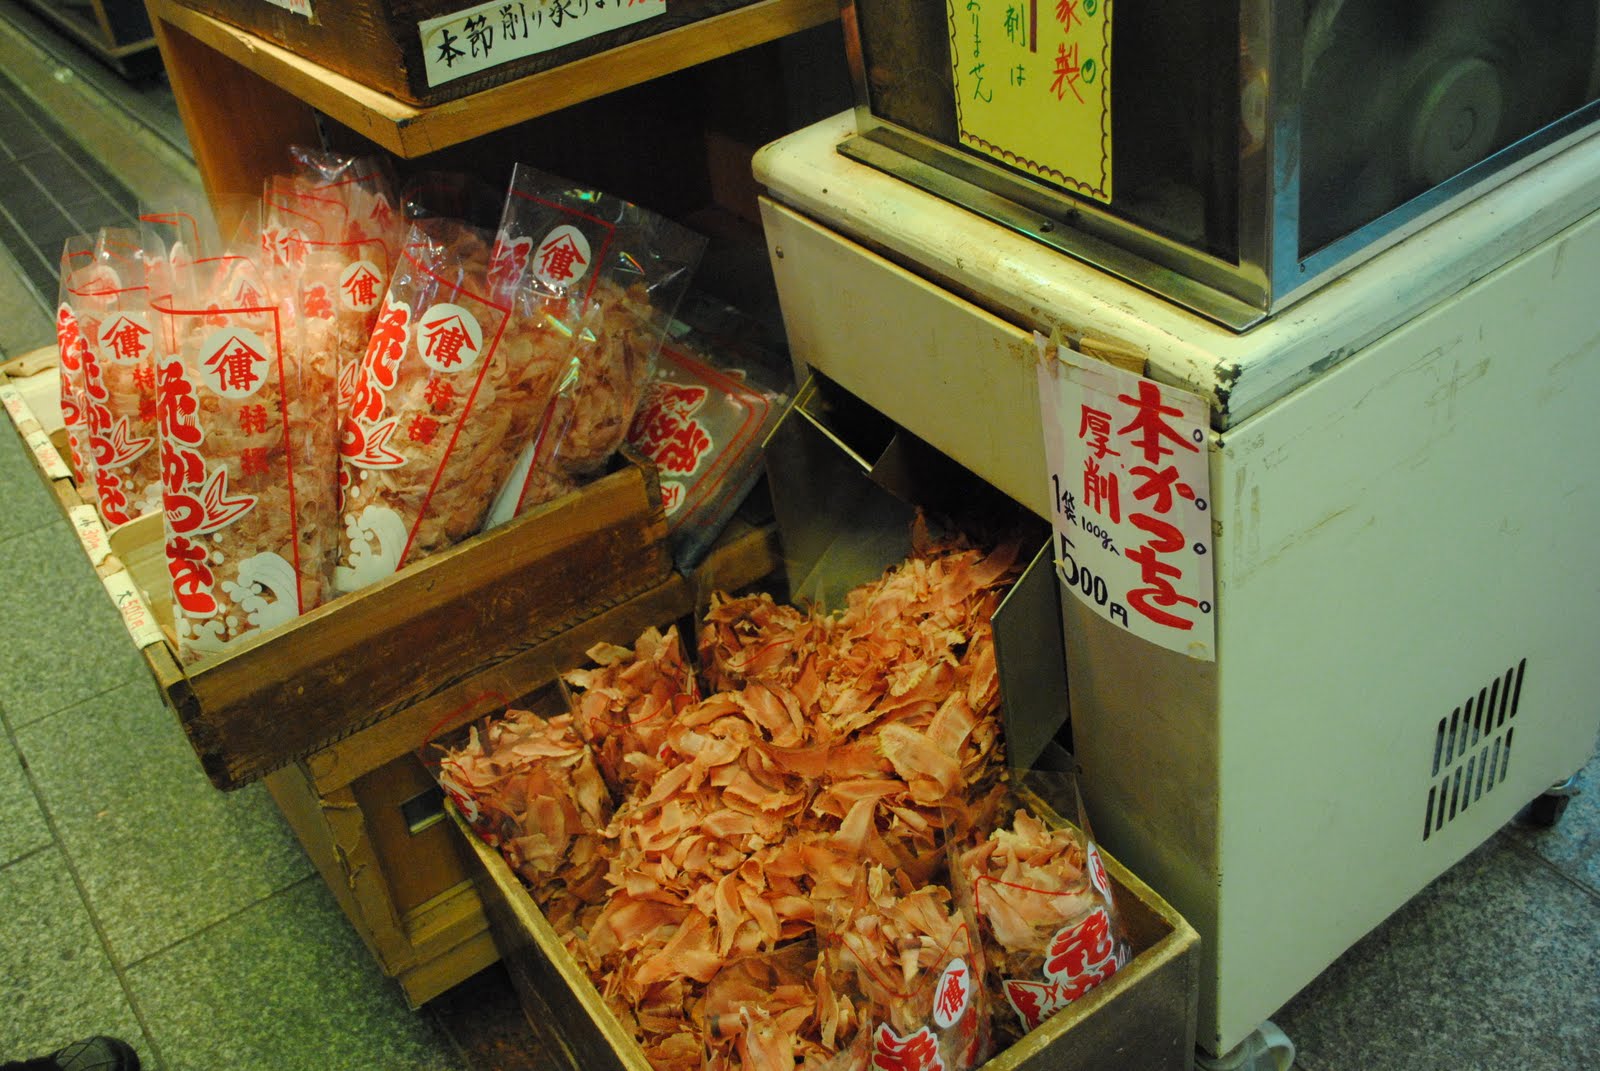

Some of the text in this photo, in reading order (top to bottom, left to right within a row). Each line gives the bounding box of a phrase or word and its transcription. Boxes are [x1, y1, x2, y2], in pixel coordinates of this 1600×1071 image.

[436, 0, 621, 68] 本節削り承り
[1078, 404, 1121, 524] 厚削
[1116, 380, 1200, 631] 本かつを
[1060, 532, 1129, 629] 500円
